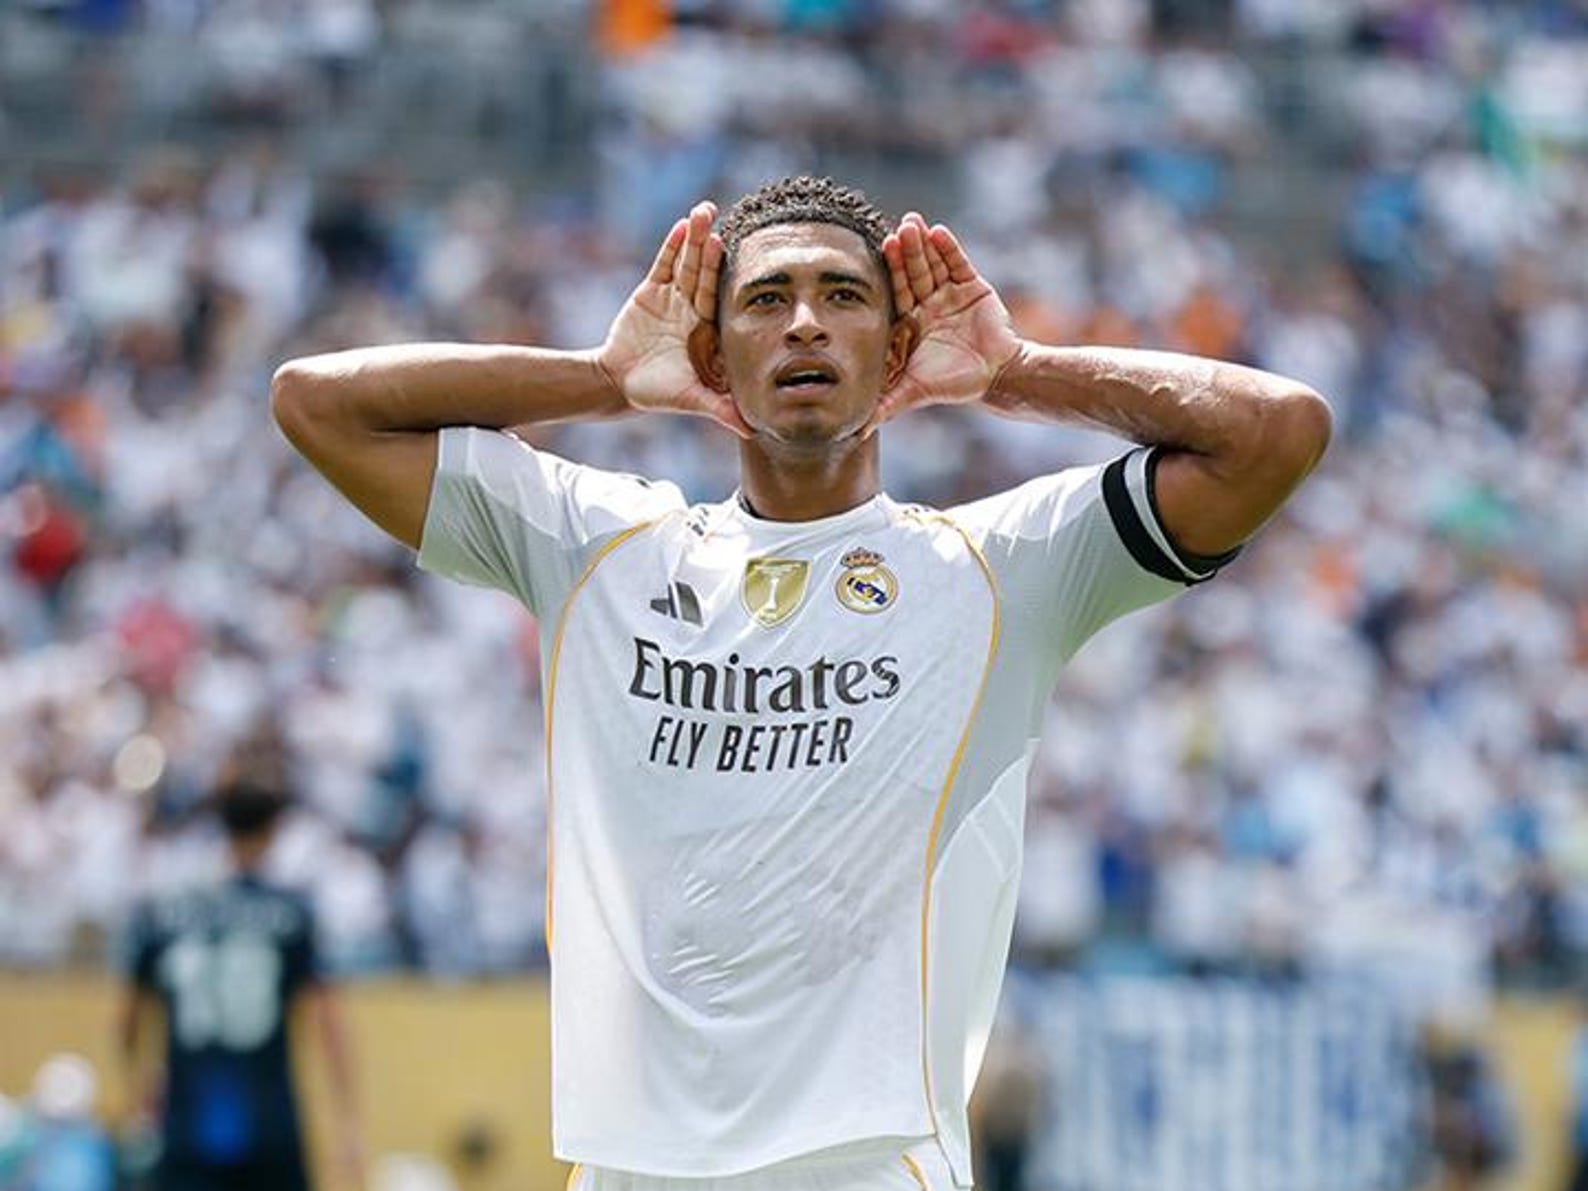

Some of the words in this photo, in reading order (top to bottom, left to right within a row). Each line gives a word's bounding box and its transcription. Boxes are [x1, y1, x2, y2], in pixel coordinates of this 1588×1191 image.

[628, 637, 901, 713] Emirates
[650, 715, 708, 770] FLY
[716, 716, 854, 773] BETTER
